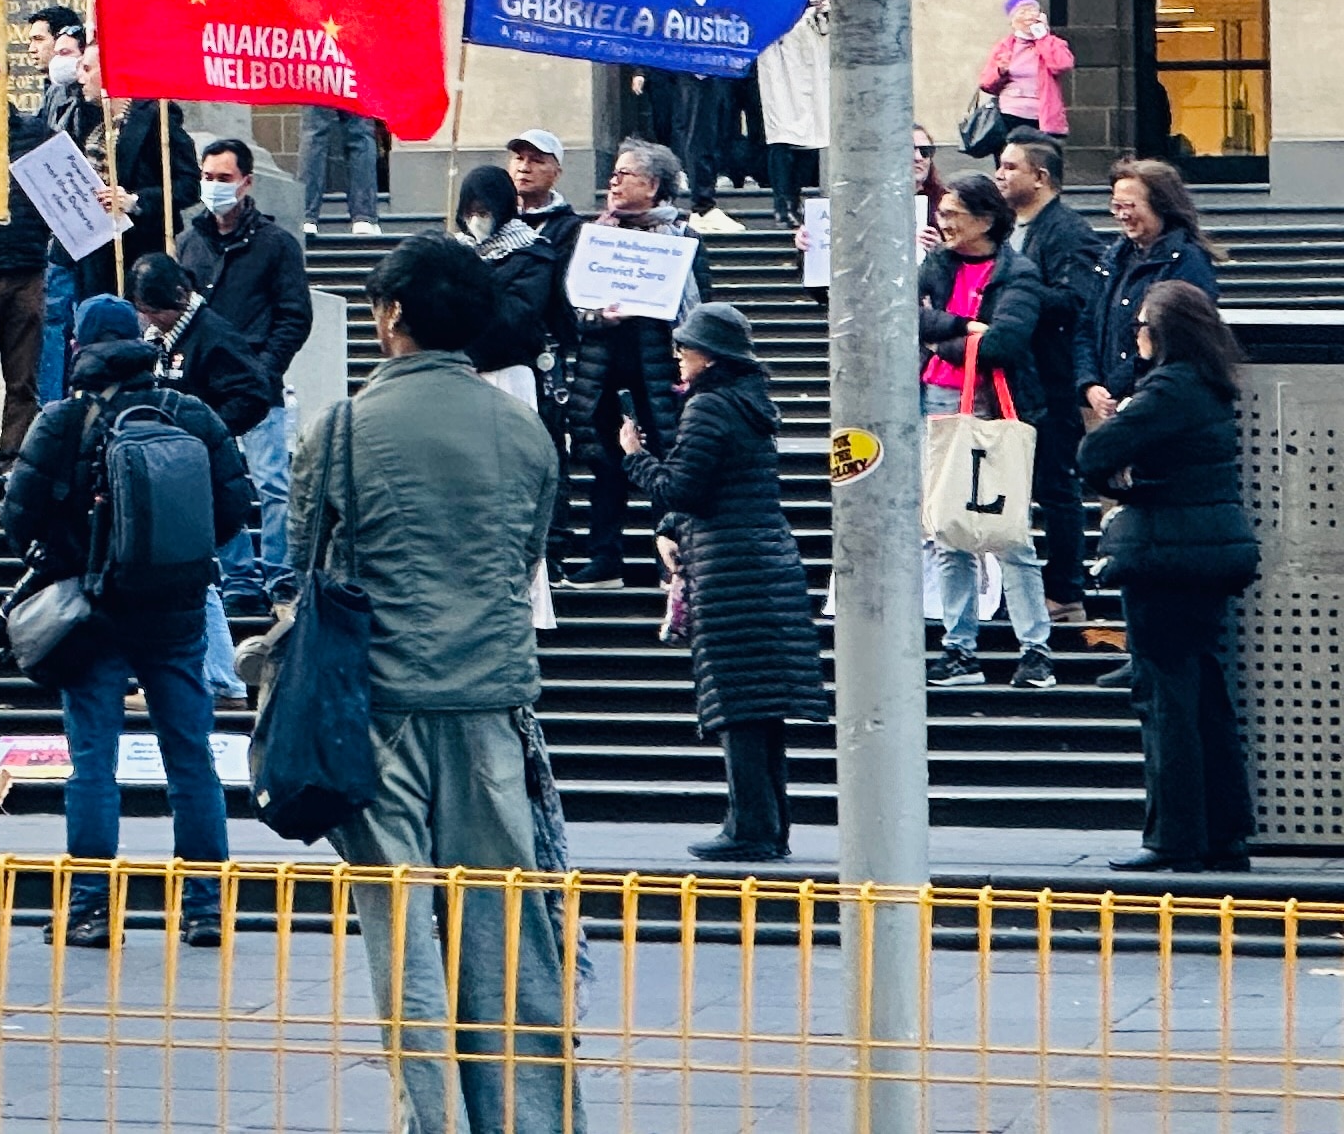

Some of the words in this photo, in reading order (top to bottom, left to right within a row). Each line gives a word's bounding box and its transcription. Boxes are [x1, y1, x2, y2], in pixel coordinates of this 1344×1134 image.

[203, 54, 358, 99] MELBOURNE
[588, 261, 634, 278] Convict
[635, 267, 667, 282] Sara
[965, 448, 1007, 515] L
